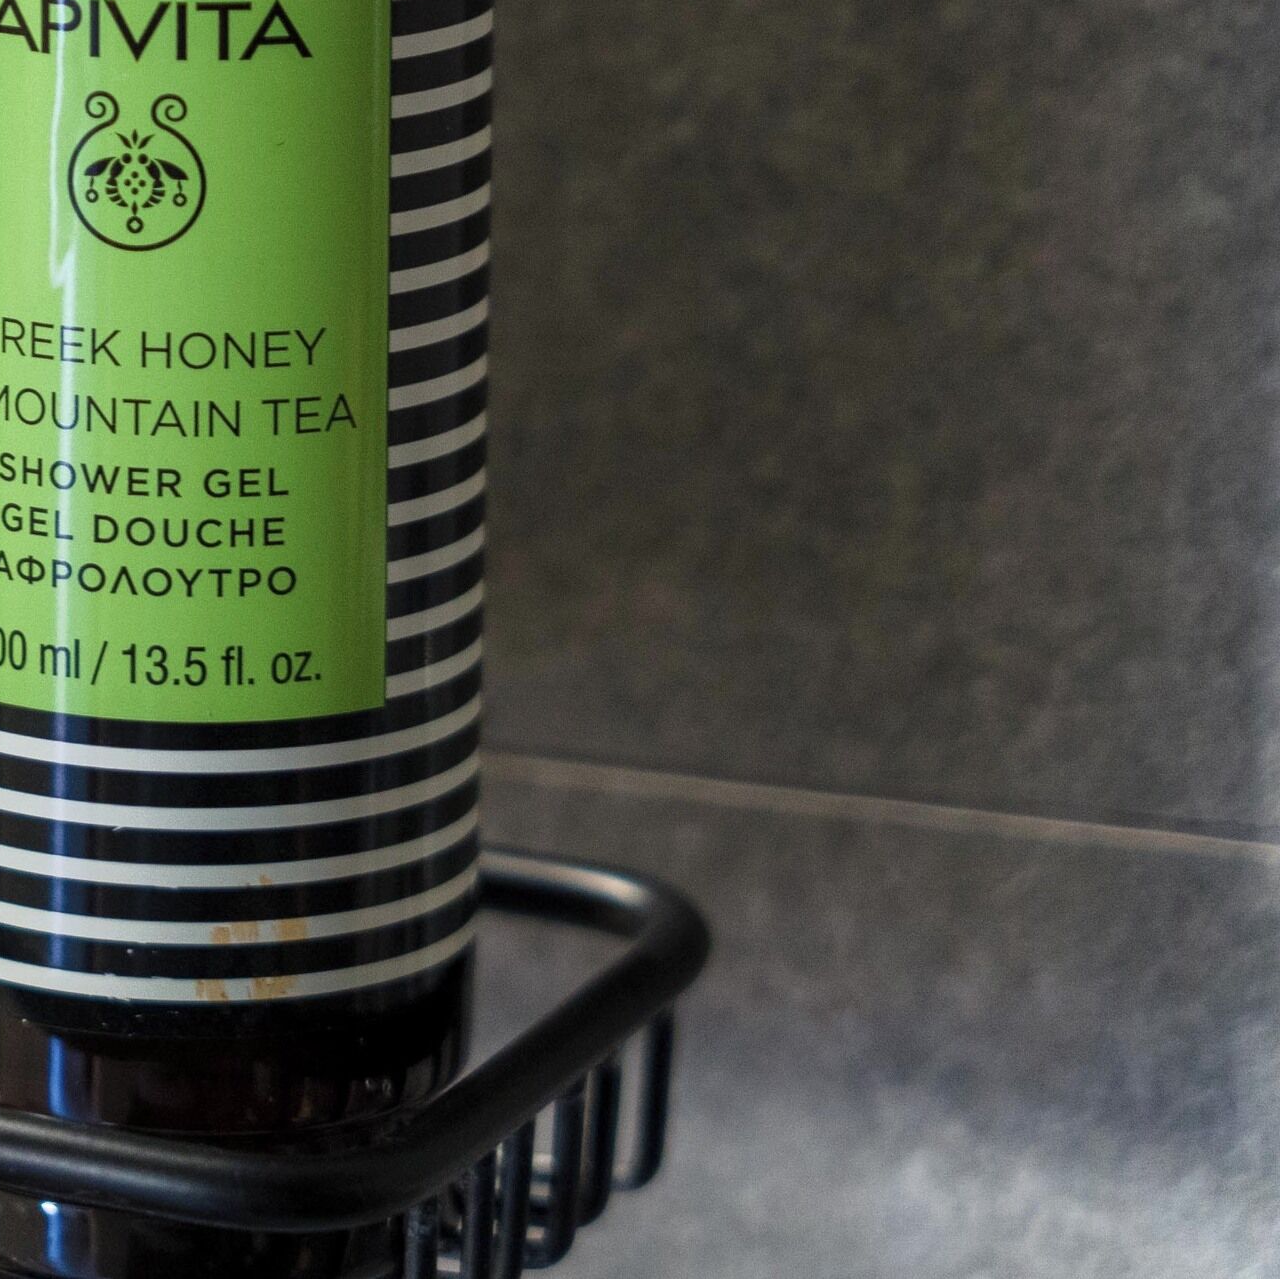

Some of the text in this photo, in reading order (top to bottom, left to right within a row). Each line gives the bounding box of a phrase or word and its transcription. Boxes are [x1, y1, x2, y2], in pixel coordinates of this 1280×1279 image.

[141, 328, 326, 369] HONEY
[262, 394, 357, 435] TEA
[0, 453, 289, 498] SHOWER GEL
[1, 503, 285, 548] GEL DOUCHE
[40, 639, 80, 679] ml
[91, 641, 108, 685] /
[122, 644, 207, 686] 13.5
[221, 646, 255, 686] fl.
[271, 651, 321, 684] oz.
